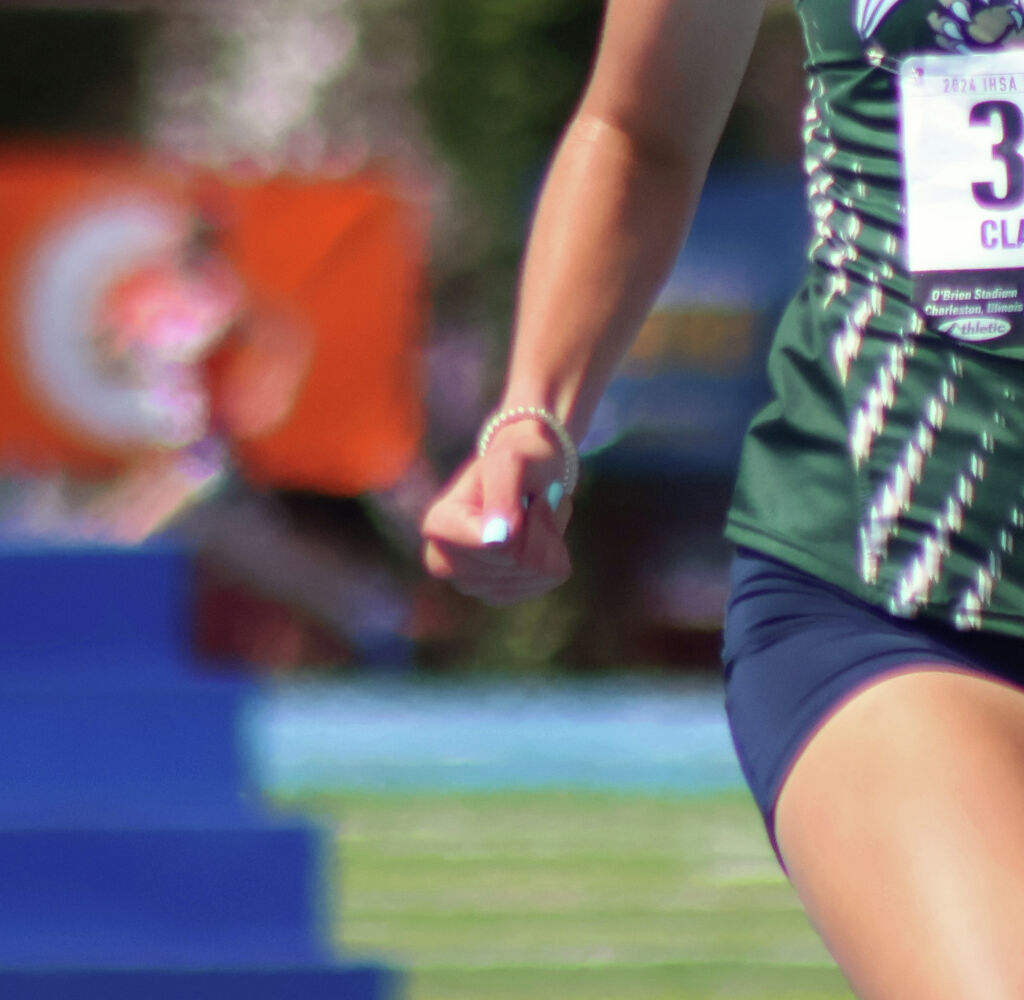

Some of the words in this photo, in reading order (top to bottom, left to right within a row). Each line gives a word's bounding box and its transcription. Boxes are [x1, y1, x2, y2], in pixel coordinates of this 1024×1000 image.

[983, 75, 1017, 92] IHSA
[931, 288, 972, 302] O'Brien
[974, 286, 1018, 300] Stadium
[986, 300, 1024, 314] Illinois
